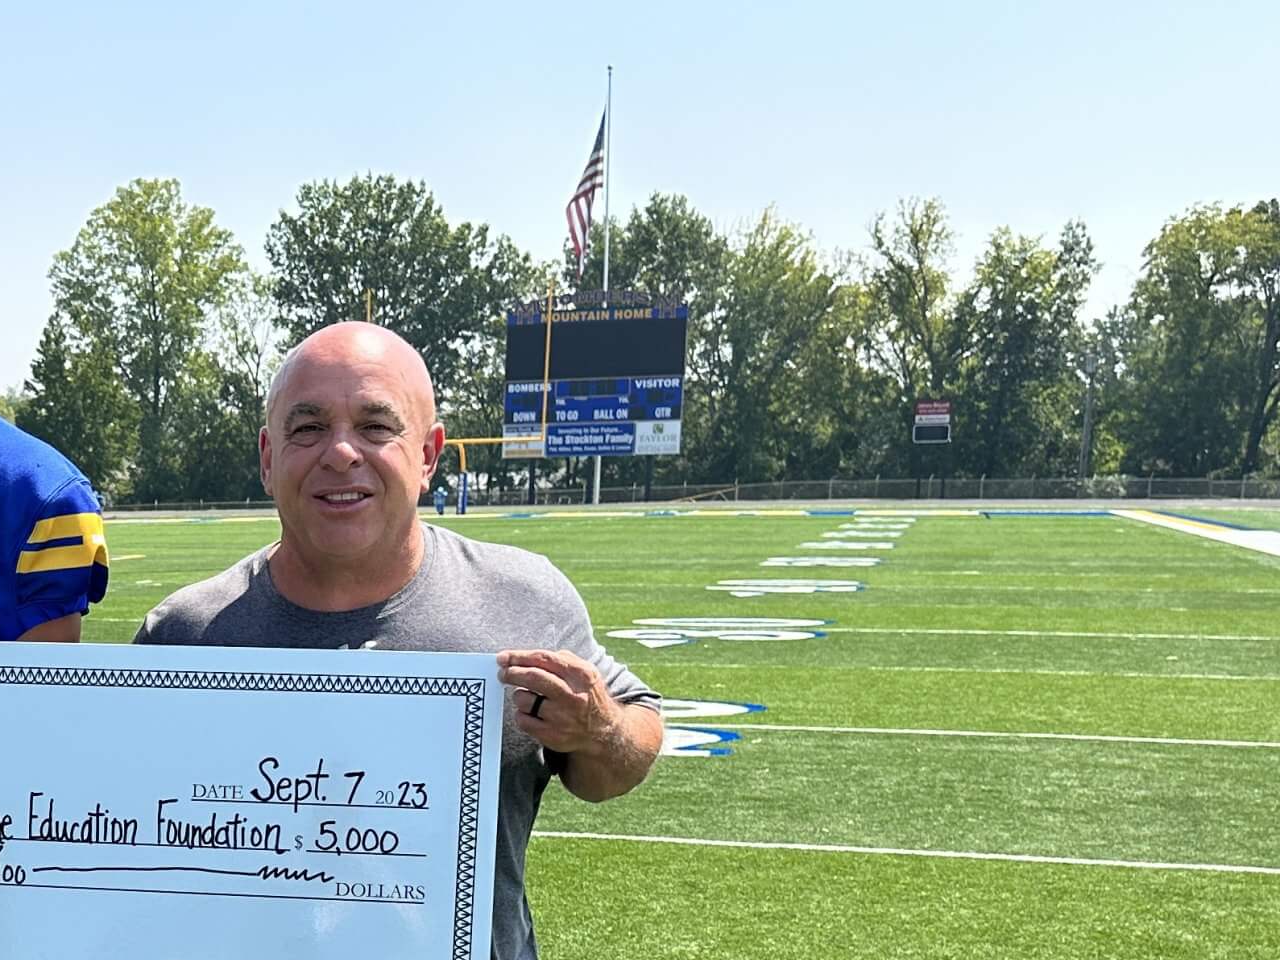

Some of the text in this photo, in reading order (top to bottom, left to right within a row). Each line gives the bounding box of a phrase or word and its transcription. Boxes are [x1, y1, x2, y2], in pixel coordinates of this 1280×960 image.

[614, 308, 652, 320] HOME
[635, 378, 680, 389] VISITOR
[513, 411, 536, 422] DOWN
[556, 410, 578, 421] TO GO
[593, 408, 628, 419] BALL ON
[655, 407, 671, 418] QTR
[548, 434, 633, 445] The Stockton Family
[192, 784, 243, 799] DATE
[250, 757, 329, 813] Sept.
[344, 771, 365, 804] 7
[28, 791, 138, 846] Education
[157, 799, 285, 854] Foundation
[315, 821, 399, 856] 5,000
[335, 882, 425, 900] DOLLARS
